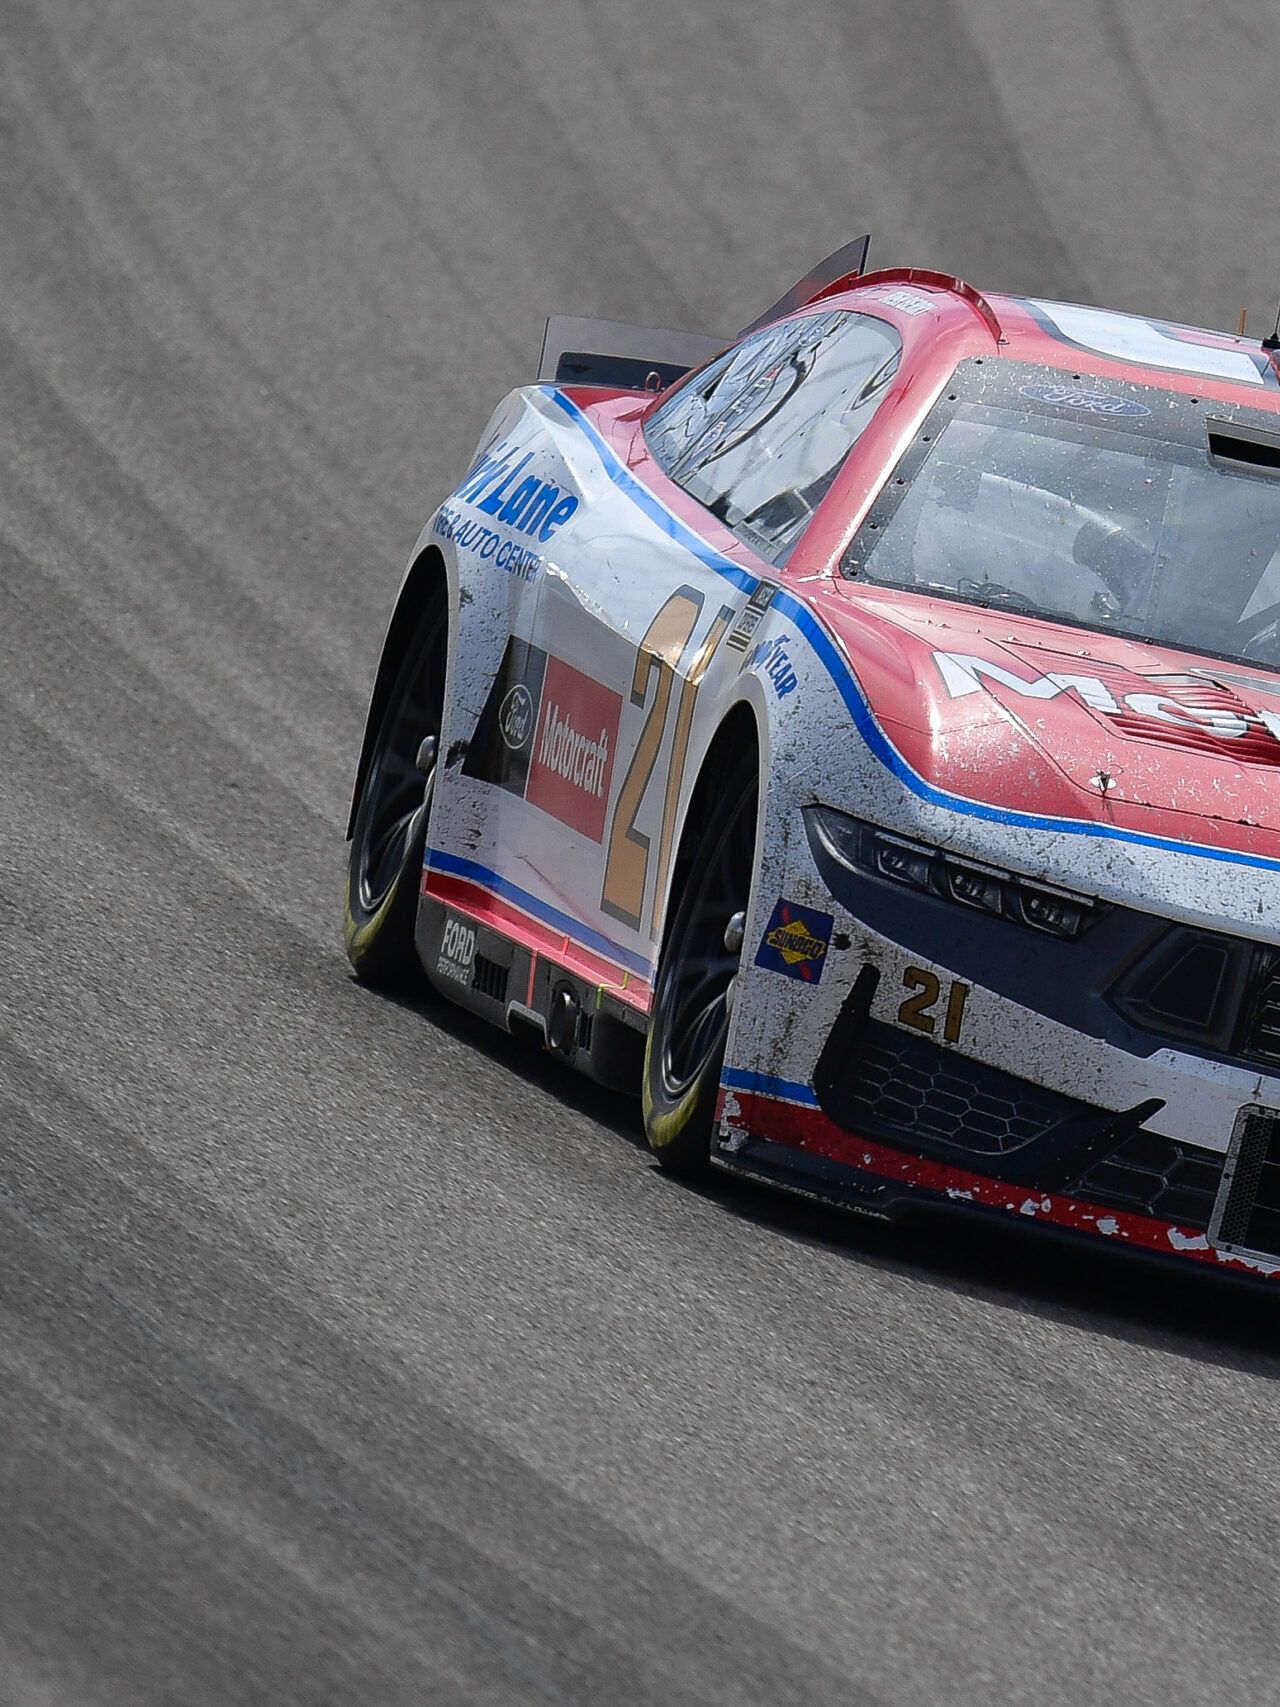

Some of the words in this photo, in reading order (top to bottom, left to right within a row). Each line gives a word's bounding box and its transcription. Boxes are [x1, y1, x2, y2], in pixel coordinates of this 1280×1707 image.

[1043, 386, 1127, 412] Ford
[476, 451, 580, 543] Lane
[454, 519, 500, 559] AUTO
[495, 540, 542, 584] CENTER
[505, 691, 529, 741] Ford
[538, 700, 609, 798] Motorcraft
[600, 583, 736, 950] 21
[441, 919, 475, 966] FORD
[898, 965, 969, 1043] 21
